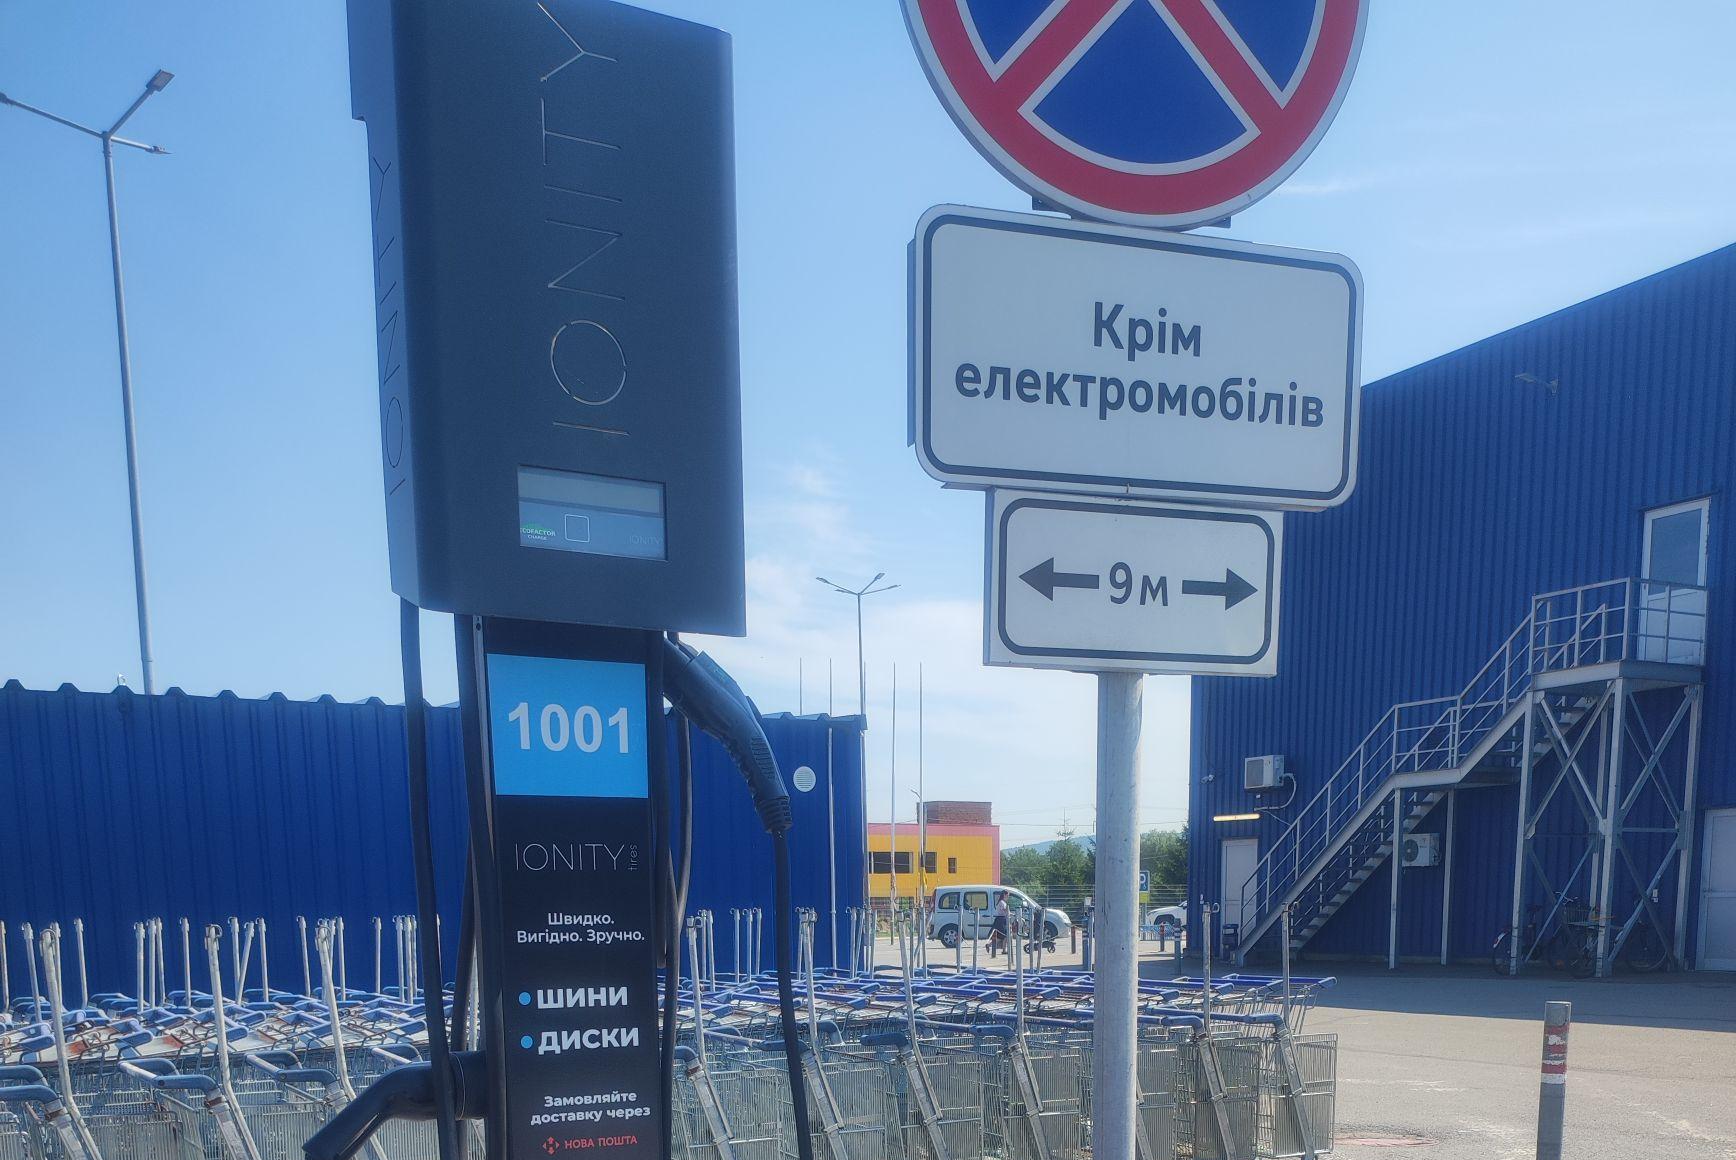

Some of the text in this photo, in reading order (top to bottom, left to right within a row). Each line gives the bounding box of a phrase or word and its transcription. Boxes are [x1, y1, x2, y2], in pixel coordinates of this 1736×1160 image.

[537, 1, 630, 437] IONITY
[373, 156, 406, 496] IONITY
[1093, 301, 1202, 361] Крім
[955, 361, 1325, 428] електромобілів
[508, 702, 629, 753] 1001
[515, 843, 637, 871] IONITY tires
[547, 912, 615, 926] Швидко.
[517, 929, 645, 945] Вигідно. Зручно.
[536, 986, 628, 1010] ШИНИ
[538, 1027, 640, 1056] ДИСКИ
[543, 1090, 637, 1108] Замовляйте
[530, 1105, 651, 1126] доставку через
[564, 1135, 638, 1150] НОВА ПОШТА
